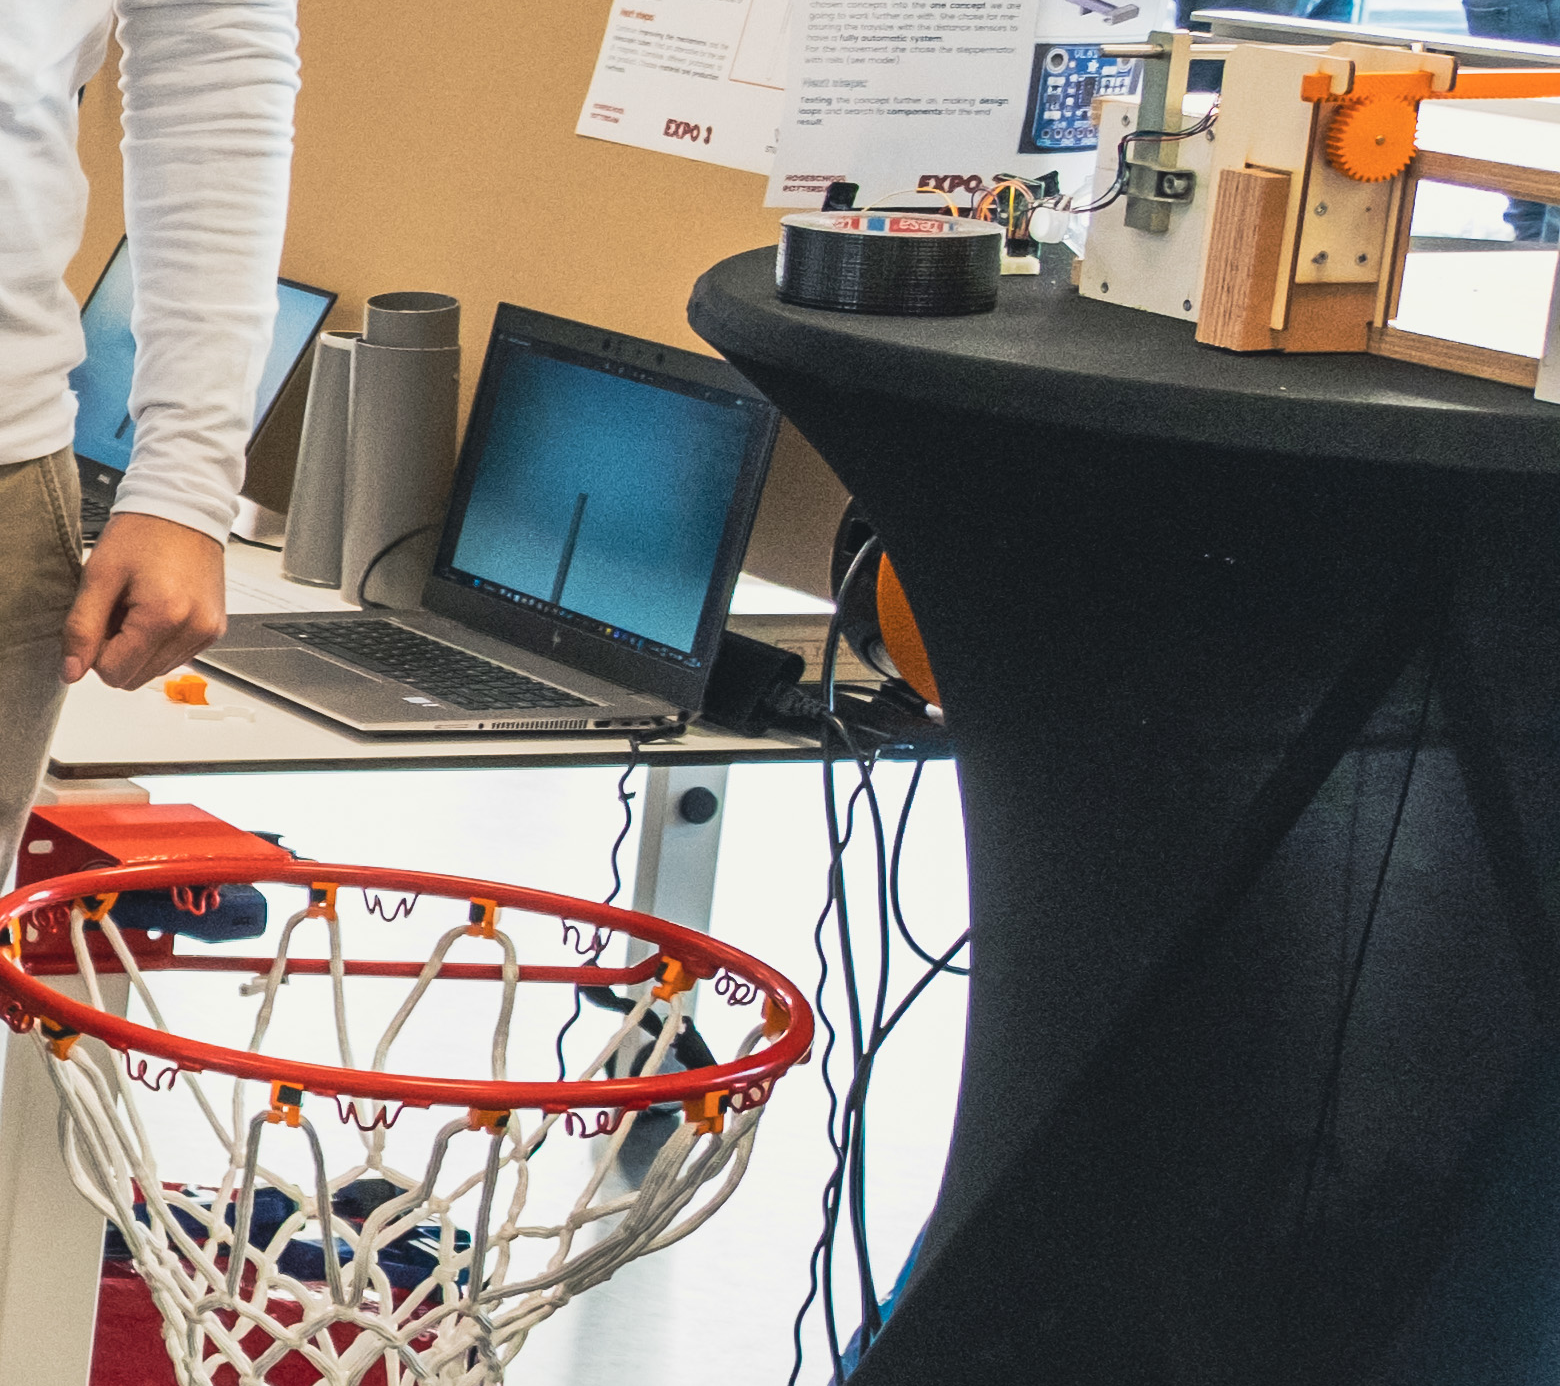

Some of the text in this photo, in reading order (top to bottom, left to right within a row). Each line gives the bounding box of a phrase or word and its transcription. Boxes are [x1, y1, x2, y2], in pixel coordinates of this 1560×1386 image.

[663, 118, 700, 142] EXPO
[917, 175, 983, 194] EXPO
[899, 218, 940, 234] tesa
